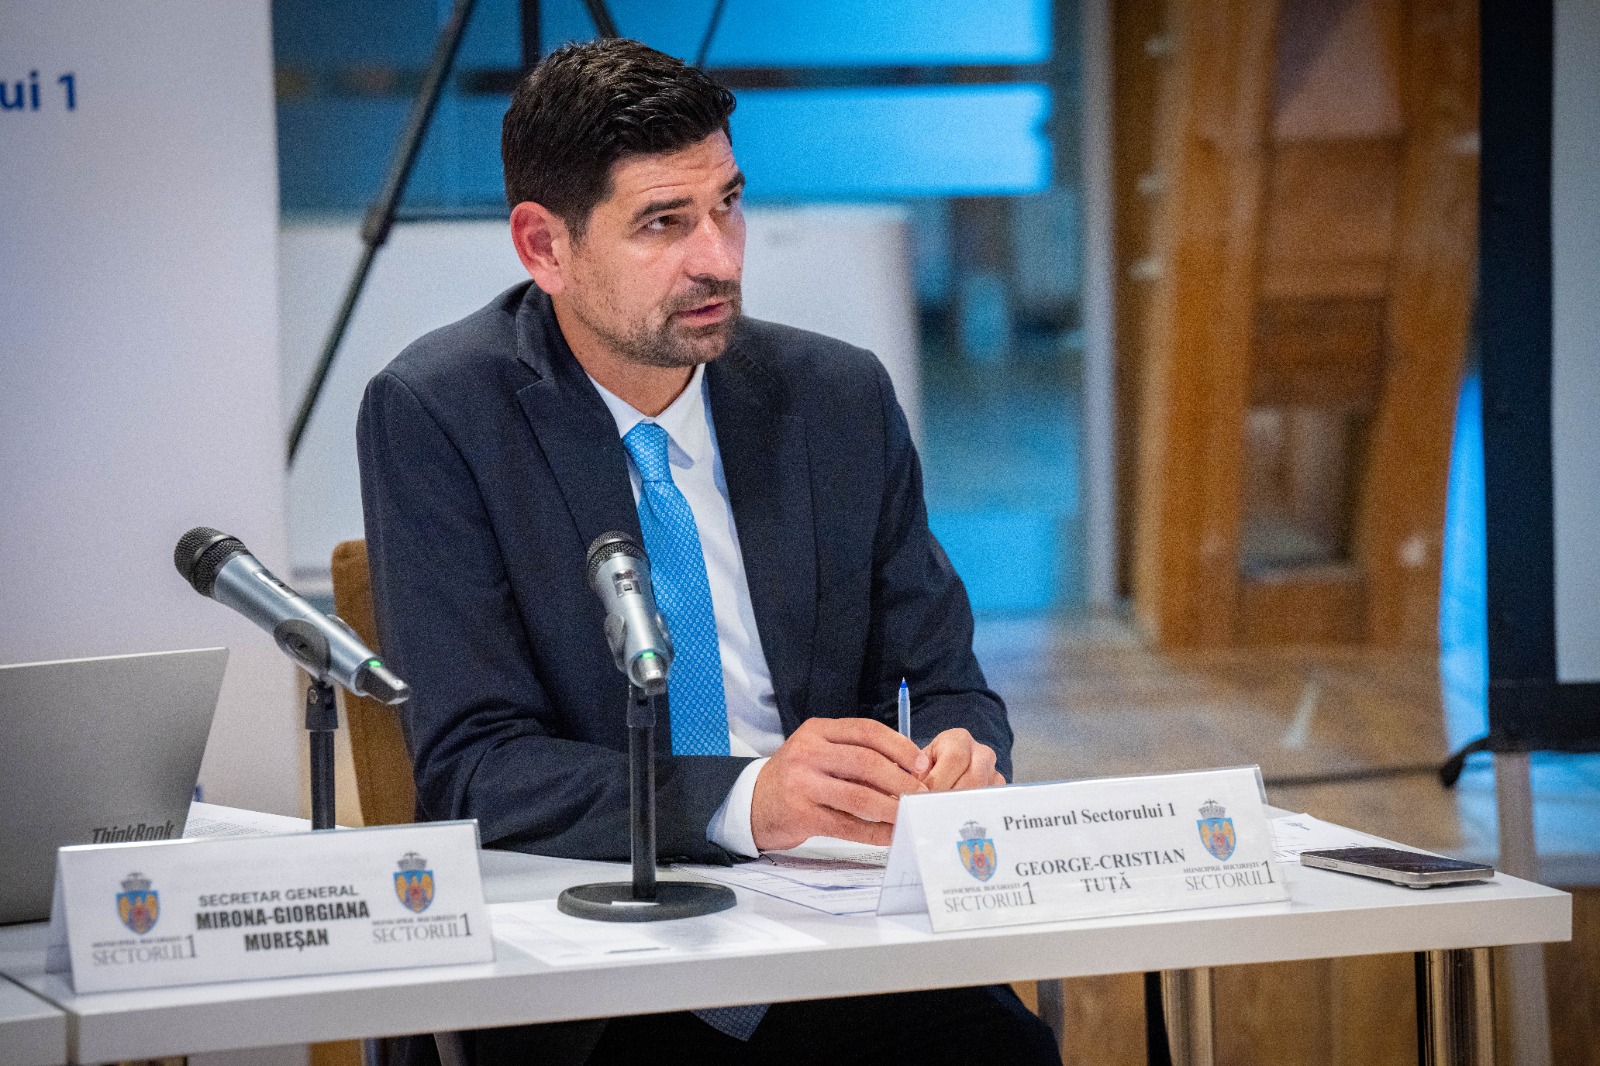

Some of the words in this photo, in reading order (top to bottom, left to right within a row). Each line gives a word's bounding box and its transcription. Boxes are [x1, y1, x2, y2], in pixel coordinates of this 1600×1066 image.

[58, 73, 76, 110] 1
[1003, 811, 1077, 831] Primarul
[1081, 803, 1164, 825] Sectorului
[1167, 802, 1177, 817] 1
[1015, 848, 1187, 877] GEORGE-CRISTIAN
[1185, 870, 1265, 891] SECTORUL
[1261, 860, 1276, 884] 1
[198, 890, 280, 907] SECRETAR
[285, 885, 359, 901] GENERAL
[944, 891, 1026, 913] SECTORUL
[1023, 881, 1037, 905] 1
[196, 901, 370, 930] MIRONA-GIORGIANA
[372, 923, 460, 944] SECTORUL
[459, 913, 473, 937] 1
[92, 945, 184, 966] SECTORUL
[185, 934, 197, 958] 1
